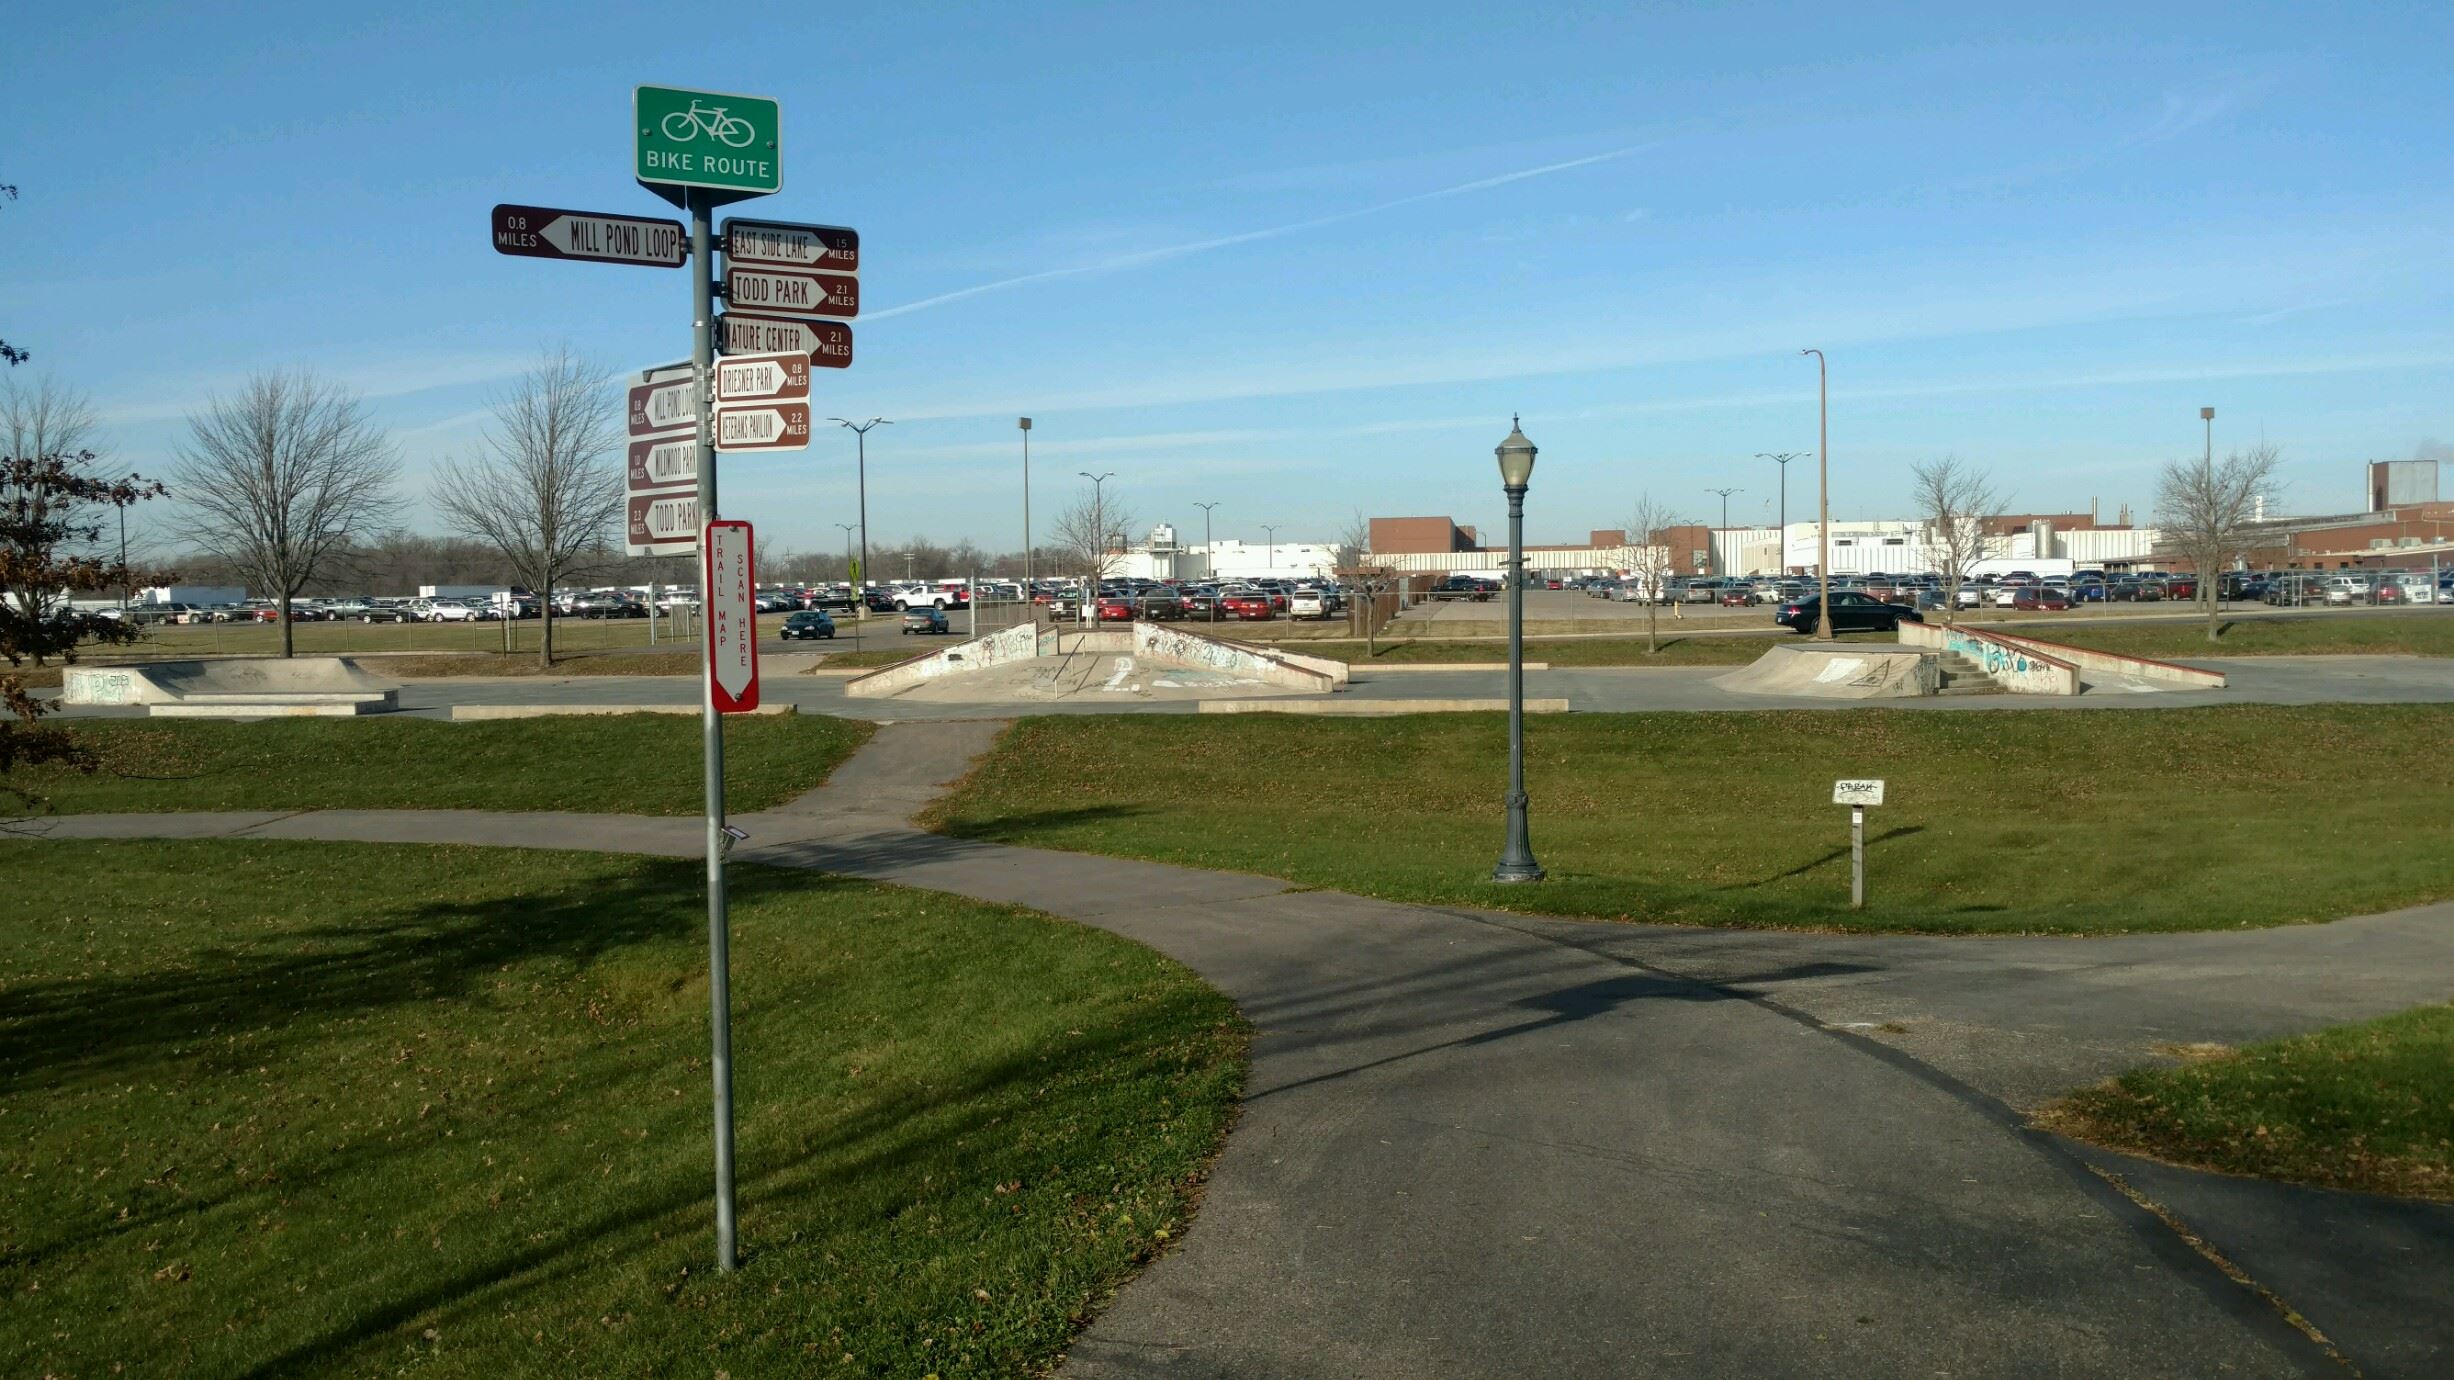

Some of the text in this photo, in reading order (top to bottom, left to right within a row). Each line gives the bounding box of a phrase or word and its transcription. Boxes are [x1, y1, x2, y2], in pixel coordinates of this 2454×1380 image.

[647, 150, 770, 178] BIKE ROUTE
[507, 216, 526, 230] 0.8
[498, 231, 537, 247] MILES
[571, 221, 677, 259] MILL POND LOOP
[734, 230, 808, 259] EAST SIDE LAKE
[828, 249, 855, 260] MILES
[735, 276, 808, 305] TODD PARK
[828, 295, 855, 306] MILES
[724, 320, 800, 353] NATURE CENTER
[822, 344, 850, 356] MILES
[723, 366, 773, 393] DRIESNER PARK
[787, 376, 807, 386] MILES
[630, 412, 645, 425] MILES
[750, 414, 773, 439] PAVILION
[786, 425, 807, 435] MILES
[630, 467, 645, 480] MILES
[656, 502, 697, 532] TODD PARK
[716, 535, 727, 647] TRAIL MAP
[737, 554, 747, 666] SCAN HERE
